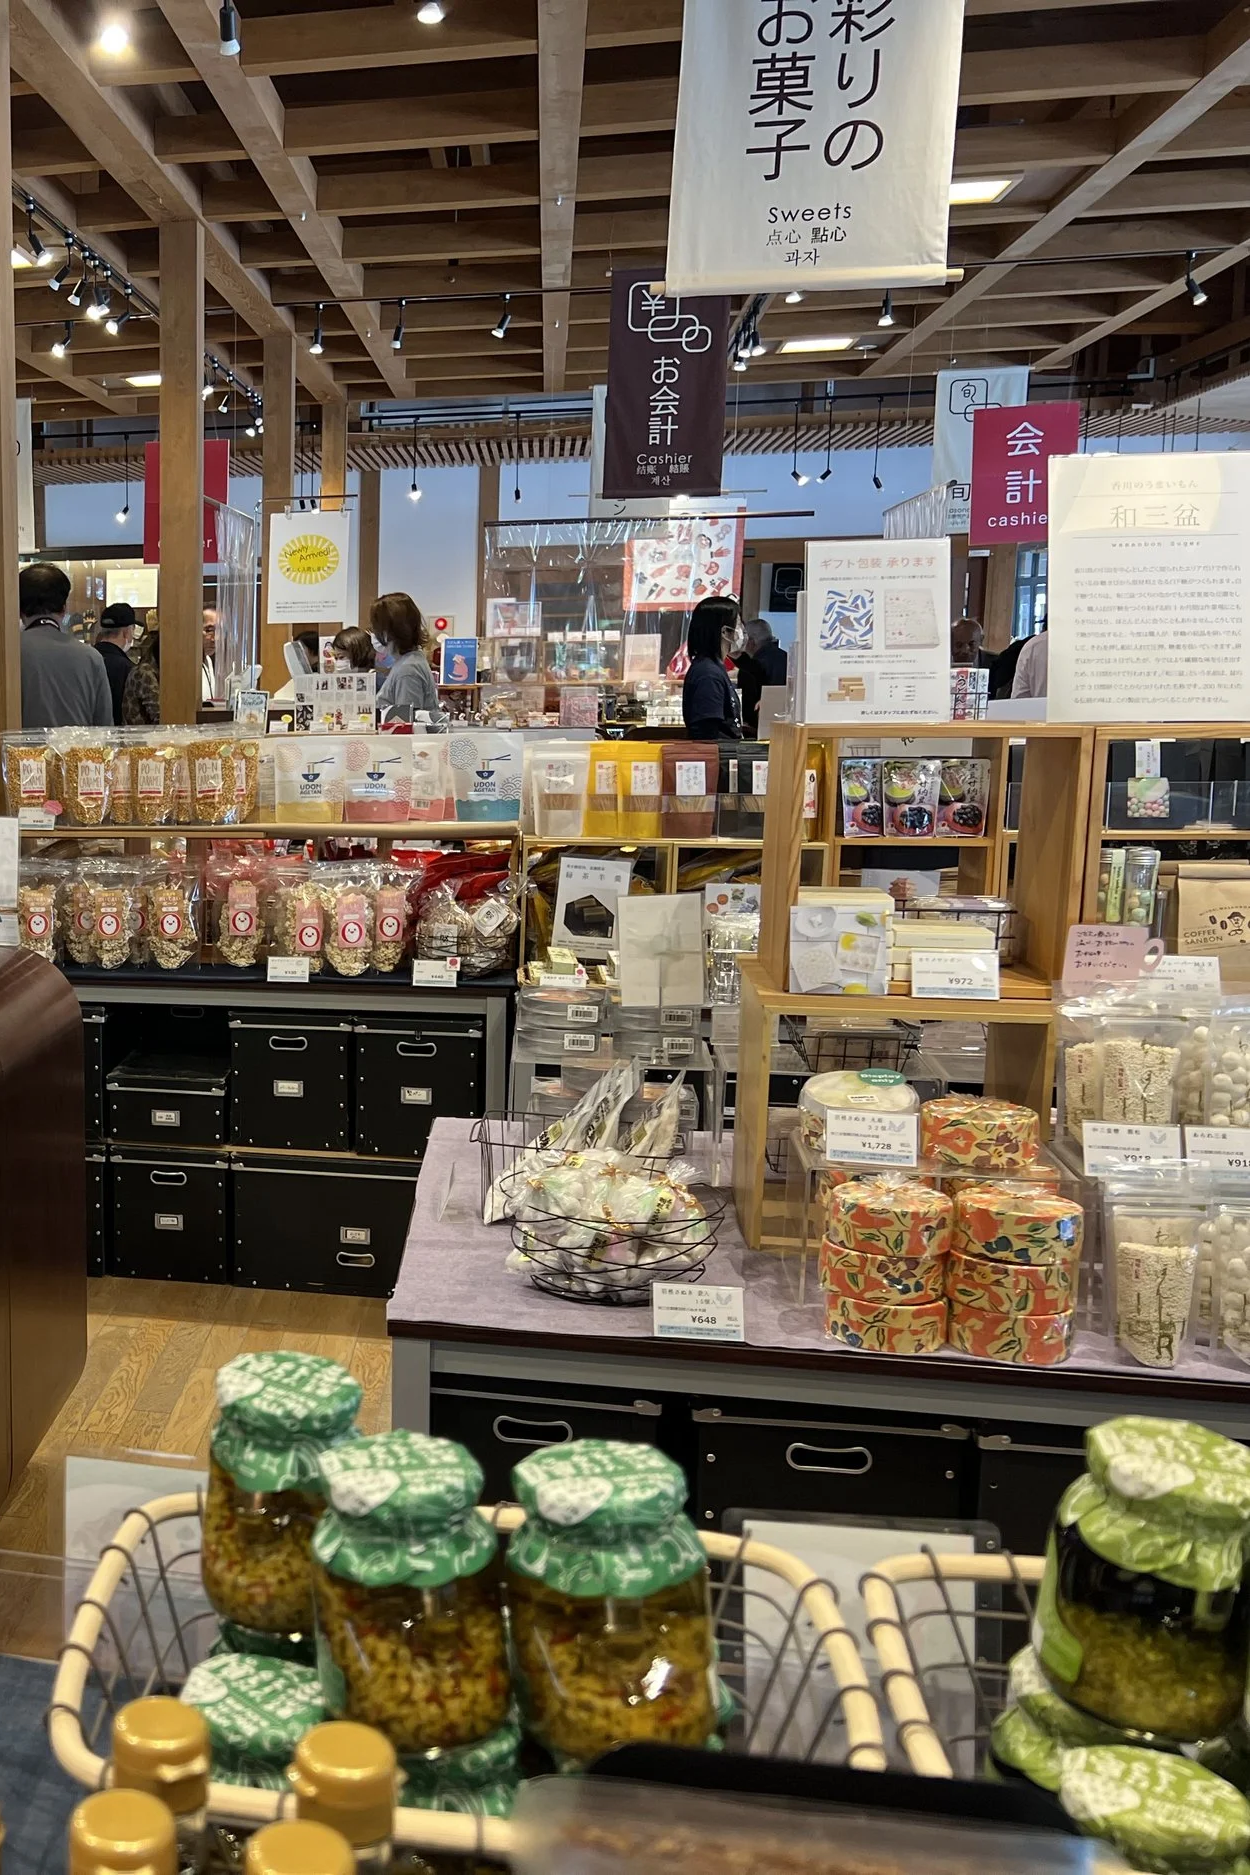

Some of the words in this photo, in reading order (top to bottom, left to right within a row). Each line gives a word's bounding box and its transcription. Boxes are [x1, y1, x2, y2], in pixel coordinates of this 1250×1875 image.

[746, 0, 814, 182] お菓子
[768, 203, 852, 223] Sweets
[766, 228, 802, 246] 点心
[811, 226, 847, 244] 點心
[785, 249, 820, 266] 과자
[648, 356, 681, 445] お会計
[636, 453, 692, 465] Cashier
[1005, 421, 1045, 504] 会計
[987, 511, 1048, 528] cashie
[1110, 503, 1200, 529] 和三盆
[1183, 929, 1218, 938] COFFEE
[1183, 936, 1223, 945] SANBON
[948, 977, 974, 985] ¥972
[862, 1141, 891, 1150] ¥1,728
[691, 1316, 717, 1325] ¥648
